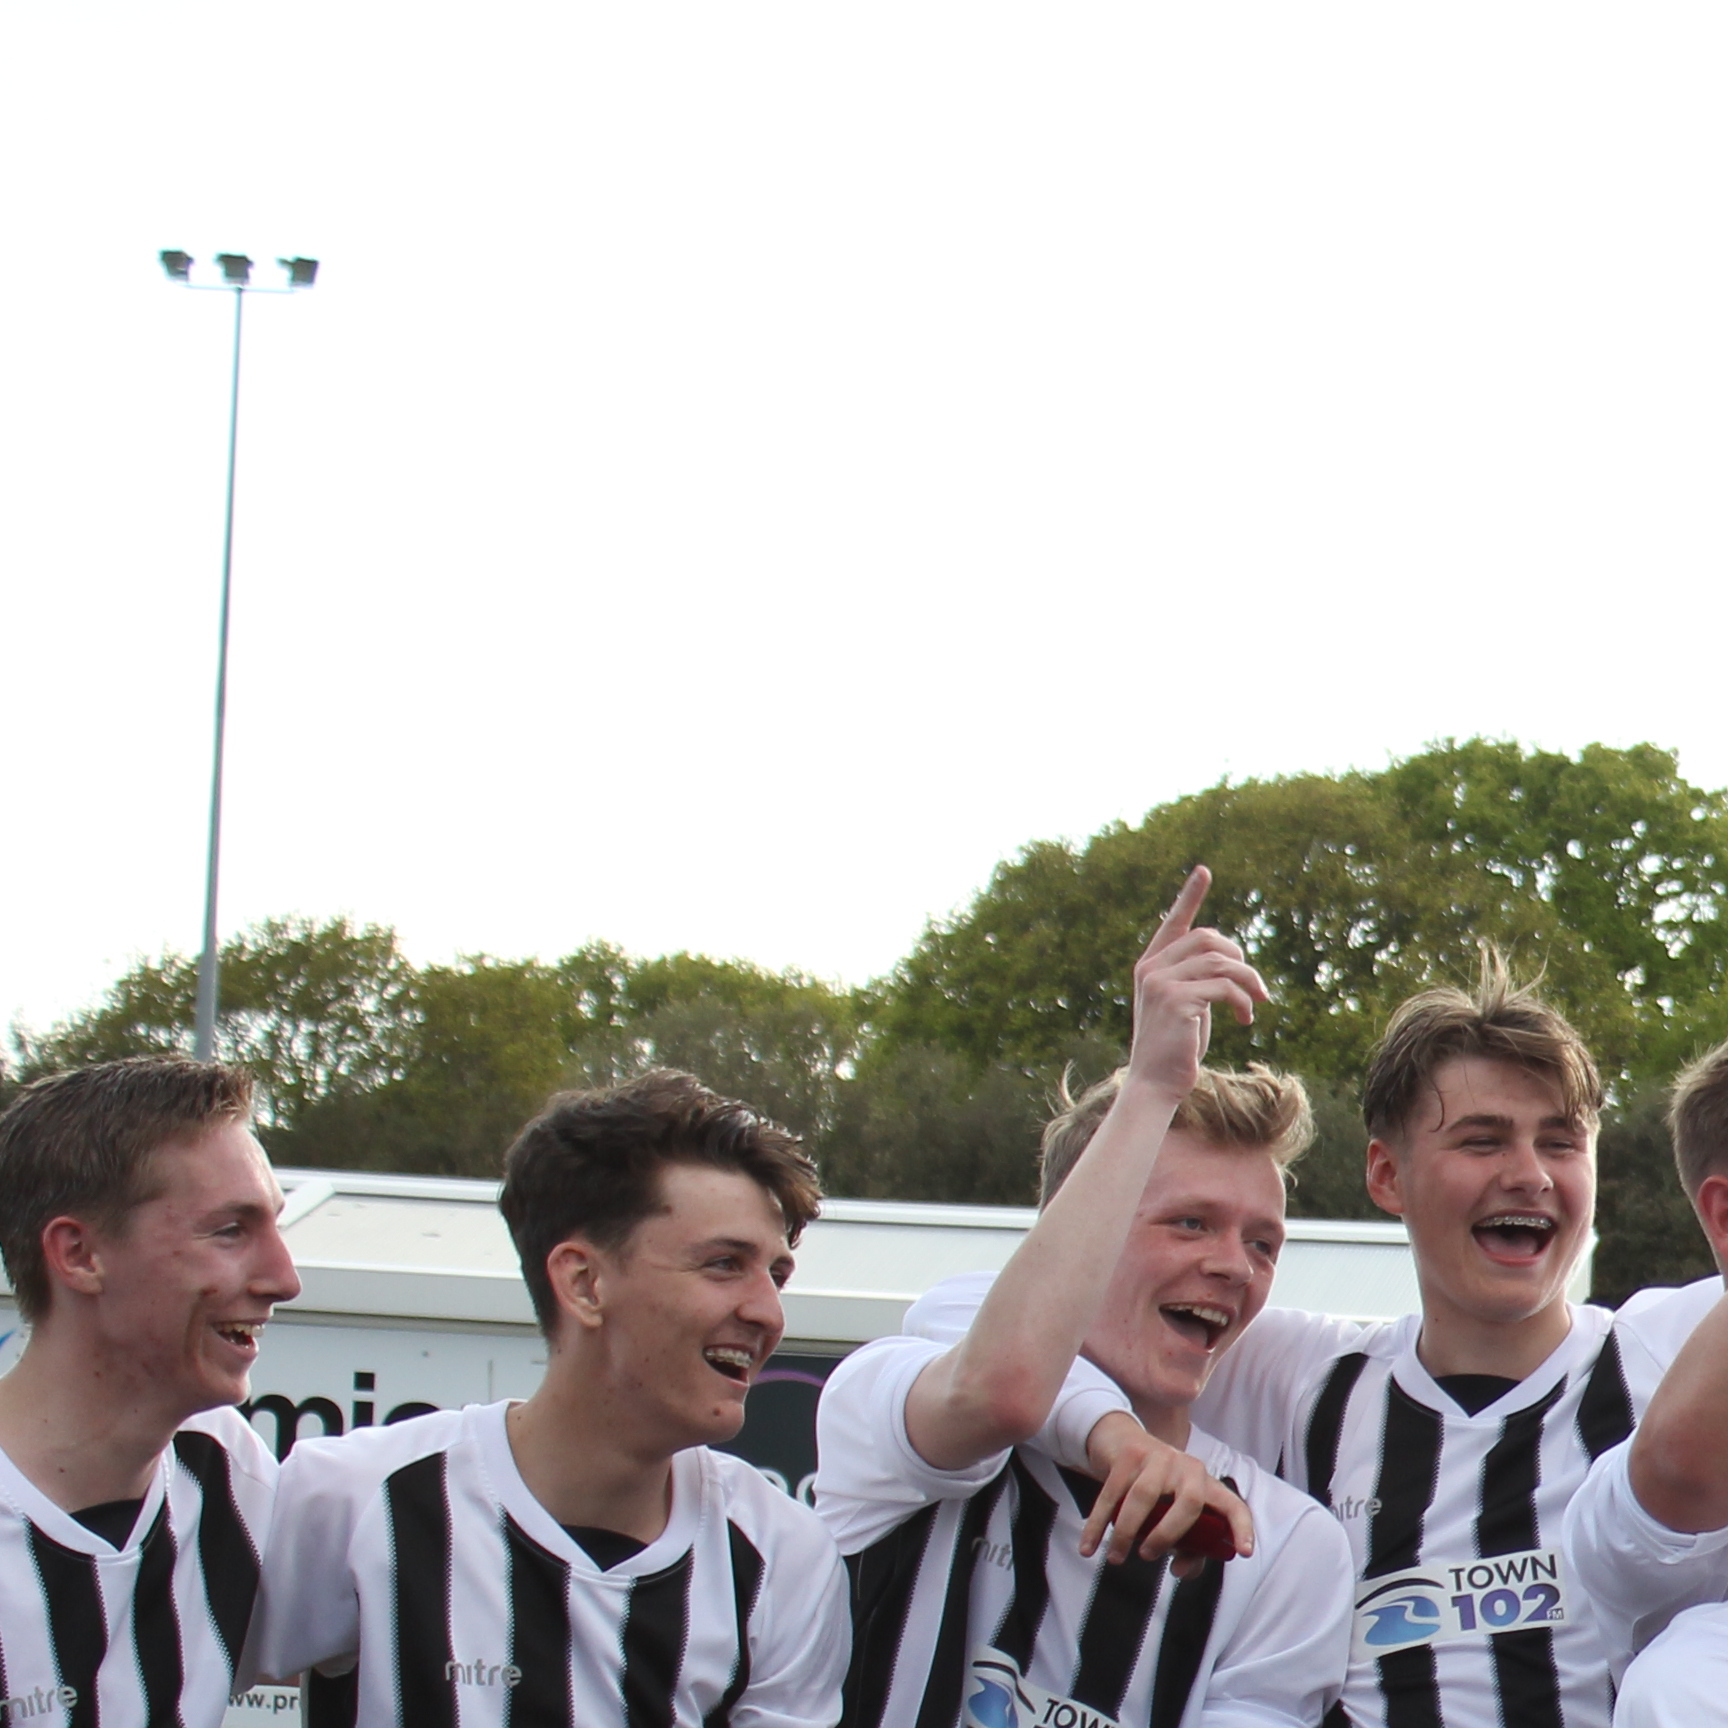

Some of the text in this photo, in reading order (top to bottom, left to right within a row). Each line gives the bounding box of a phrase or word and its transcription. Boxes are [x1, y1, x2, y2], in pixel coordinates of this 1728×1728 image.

[1448, 1554, 1558, 1592] TOWN
[1450, 1583, 1561, 1631] 102
[444, 1658, 523, 1688] mitre
